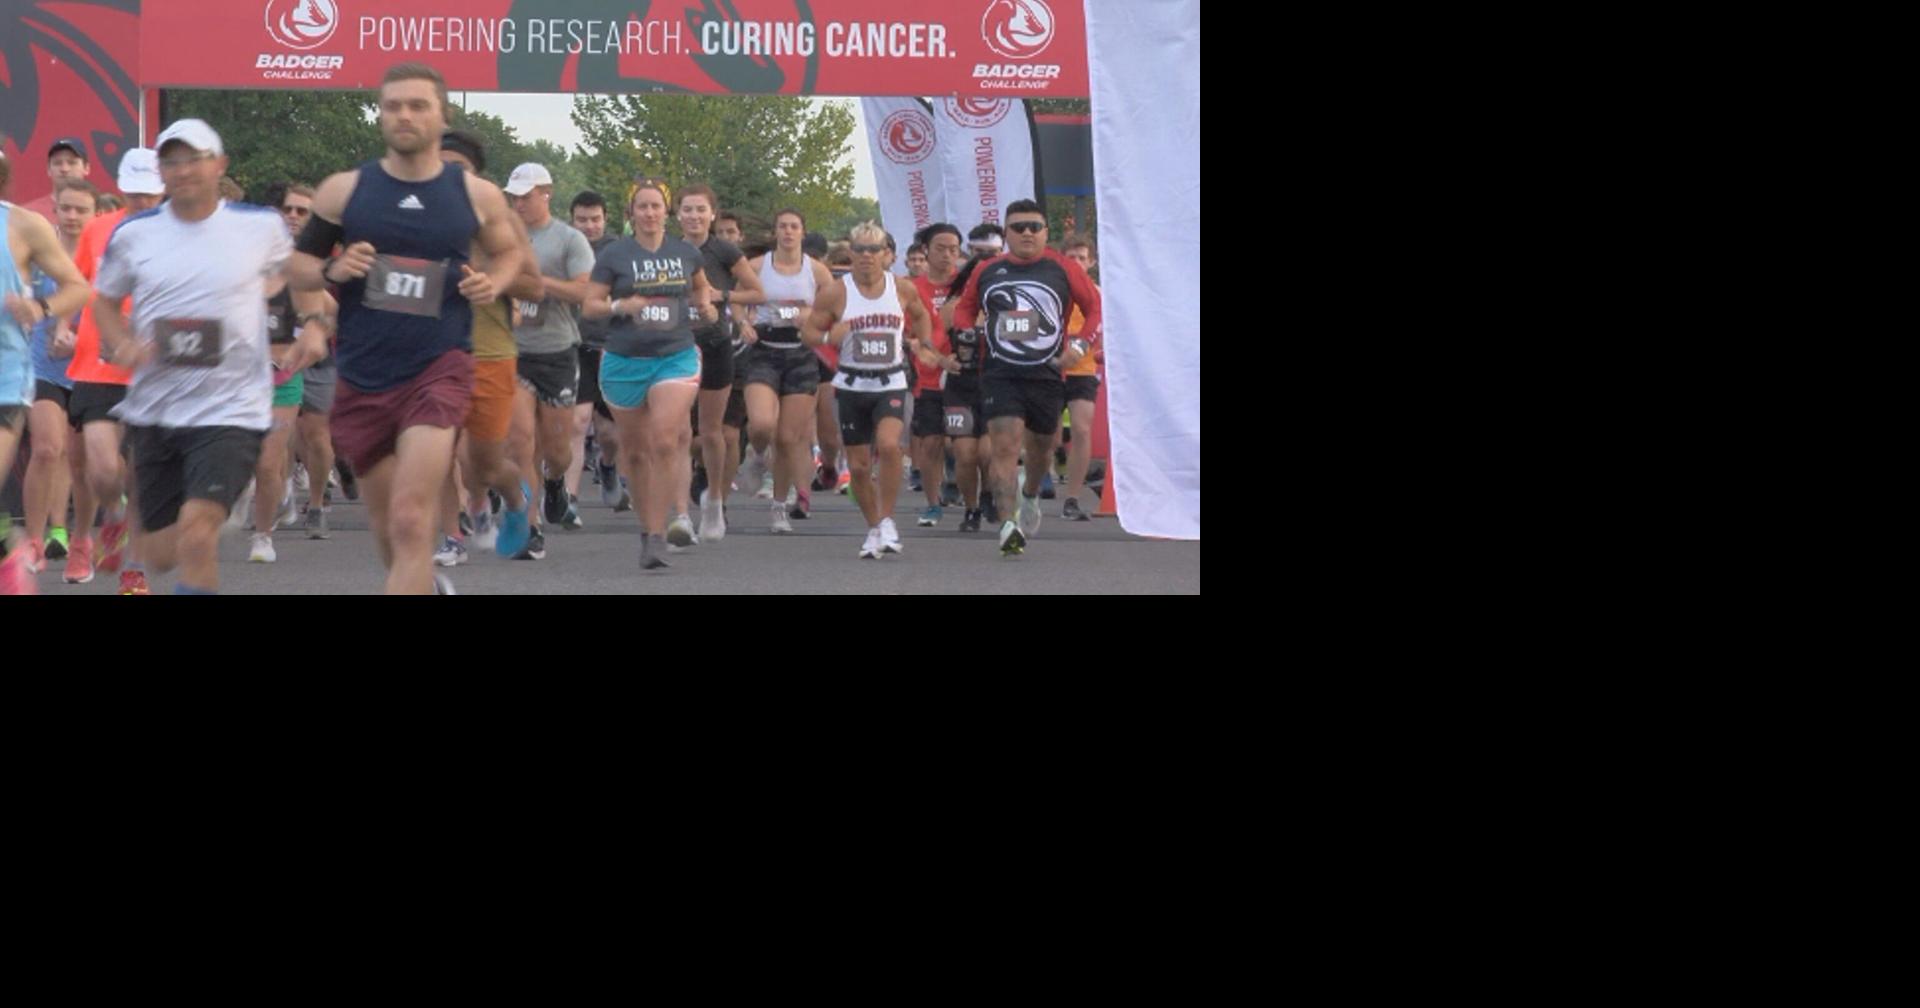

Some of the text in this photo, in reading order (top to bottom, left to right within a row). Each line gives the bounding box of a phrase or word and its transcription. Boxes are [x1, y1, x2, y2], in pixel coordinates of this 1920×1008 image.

[359, 16, 956, 58] POWERING RESEARCH. CURING CANCER.
[256, 54, 344, 69] BADGER
[263, 71, 332, 79] CHALLENGE
[973, 64, 1060, 78] BADGER
[980, 80, 1049, 88] CHALLENGE
[973, 136, 998, 206] POWERING
[632, 257, 682, 272] I RUN
[385, 271, 427, 299] 871
[1006, 318, 1030, 332] 916
[861, 340, 888, 355] 385
